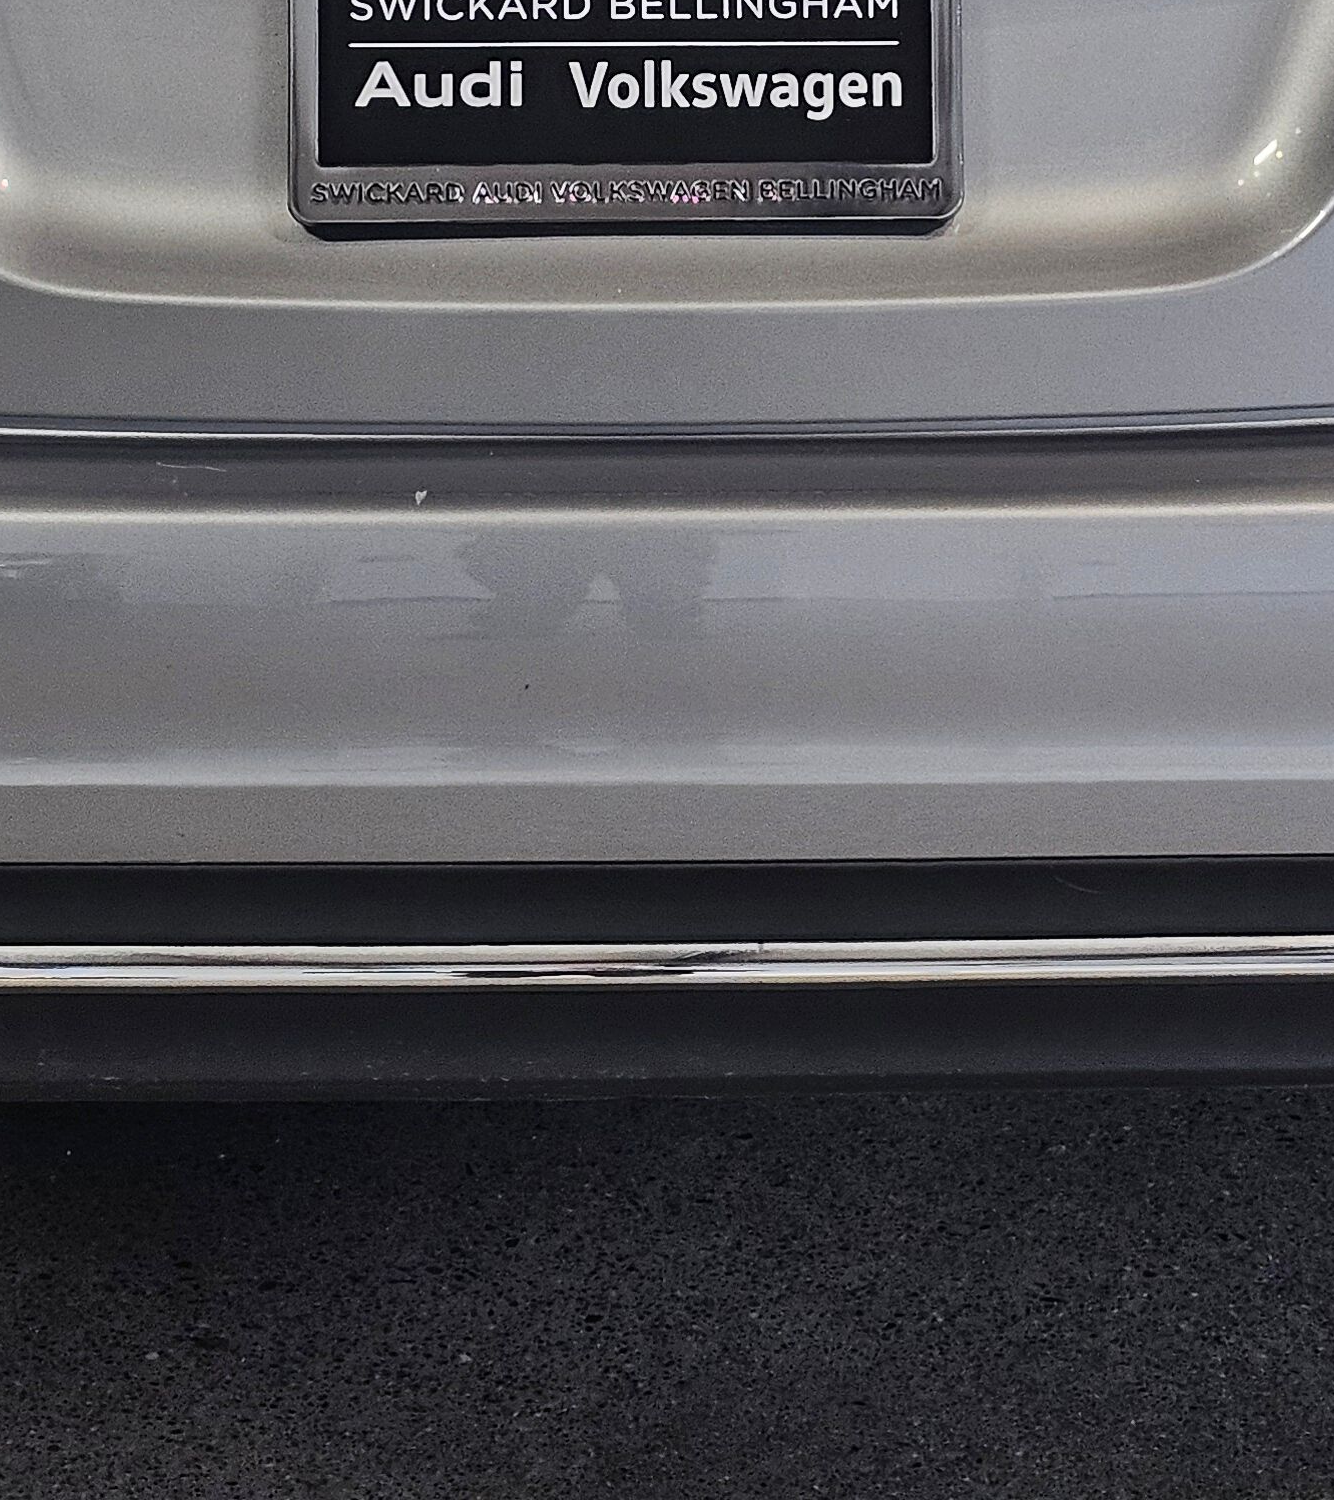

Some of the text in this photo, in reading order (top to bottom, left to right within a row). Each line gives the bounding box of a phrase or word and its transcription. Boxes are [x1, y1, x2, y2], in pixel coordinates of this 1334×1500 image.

[354, 59, 903, 121] Audi Volkswagen
[311, 177, 944, 206] SWICKARD AUDI VOLKSWAGEN BELLINGHAM
